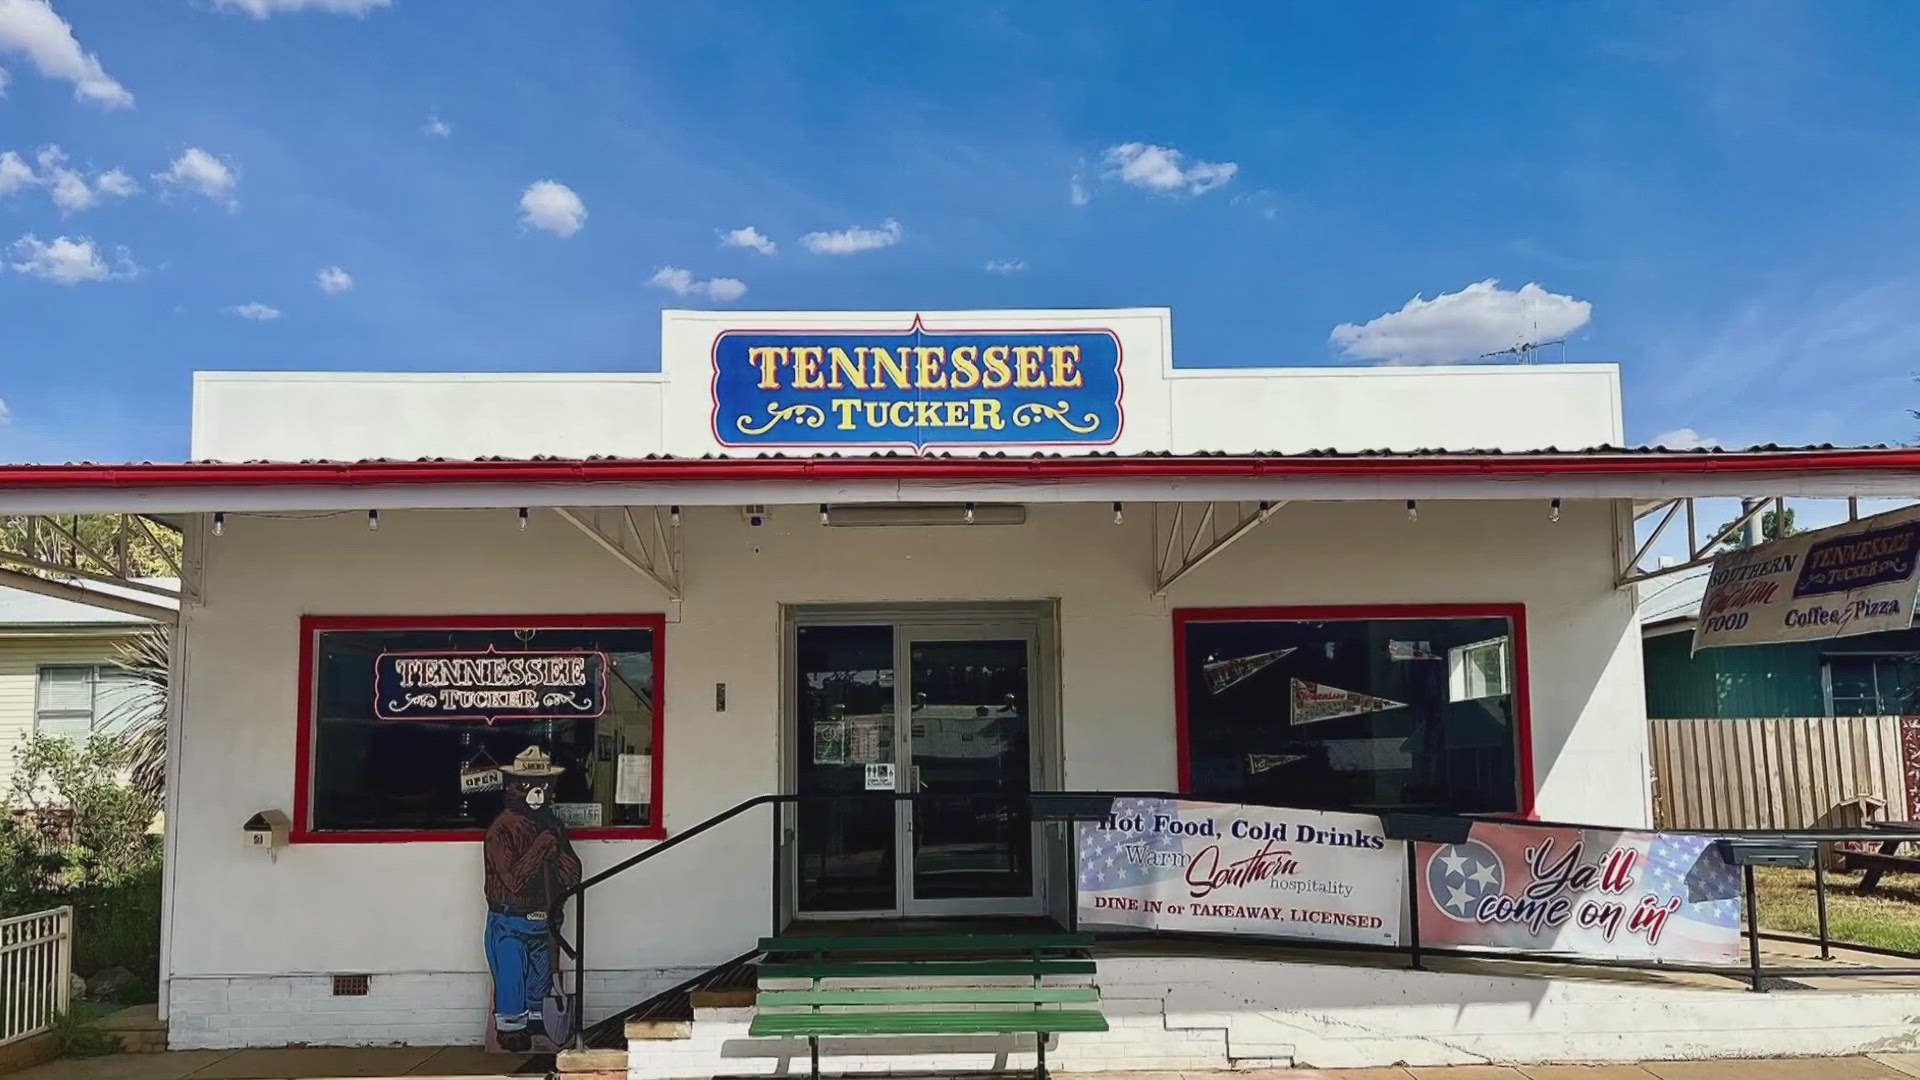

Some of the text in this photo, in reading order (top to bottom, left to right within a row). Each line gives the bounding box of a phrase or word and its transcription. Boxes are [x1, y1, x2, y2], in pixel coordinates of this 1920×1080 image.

[748, 345, 1083, 391] TENNESSEE
[832, 399, 1005, 430] TUCKER
[1710, 554, 1798, 588] SOUTHERN
[1828, 562, 1878, 585] TUCKER
[1705, 612, 1748, 634] FOOD
[1785, 606, 1839, 626] Coffee
[1854, 599, 1900, 620] Pizza
[395, 657, 586, 687] TENNESSEE
[440, 689, 539, 710] TUCKER
[466, 772, 498, 786] OPEN
[1097, 812, 1384, 850] Hot Food, Cold Drinks
[1125, 839, 1353, 898] Warm Southern hospitality
[1094, 897, 1138, 911] DINE
[1143, 900, 1163, 913] IN
[1167, 905, 1185, 915] or
[1290, 909, 1382, 929] LICENSED
[1477, 894, 1571, 936] come
[1578, 900, 1625, 942] on
